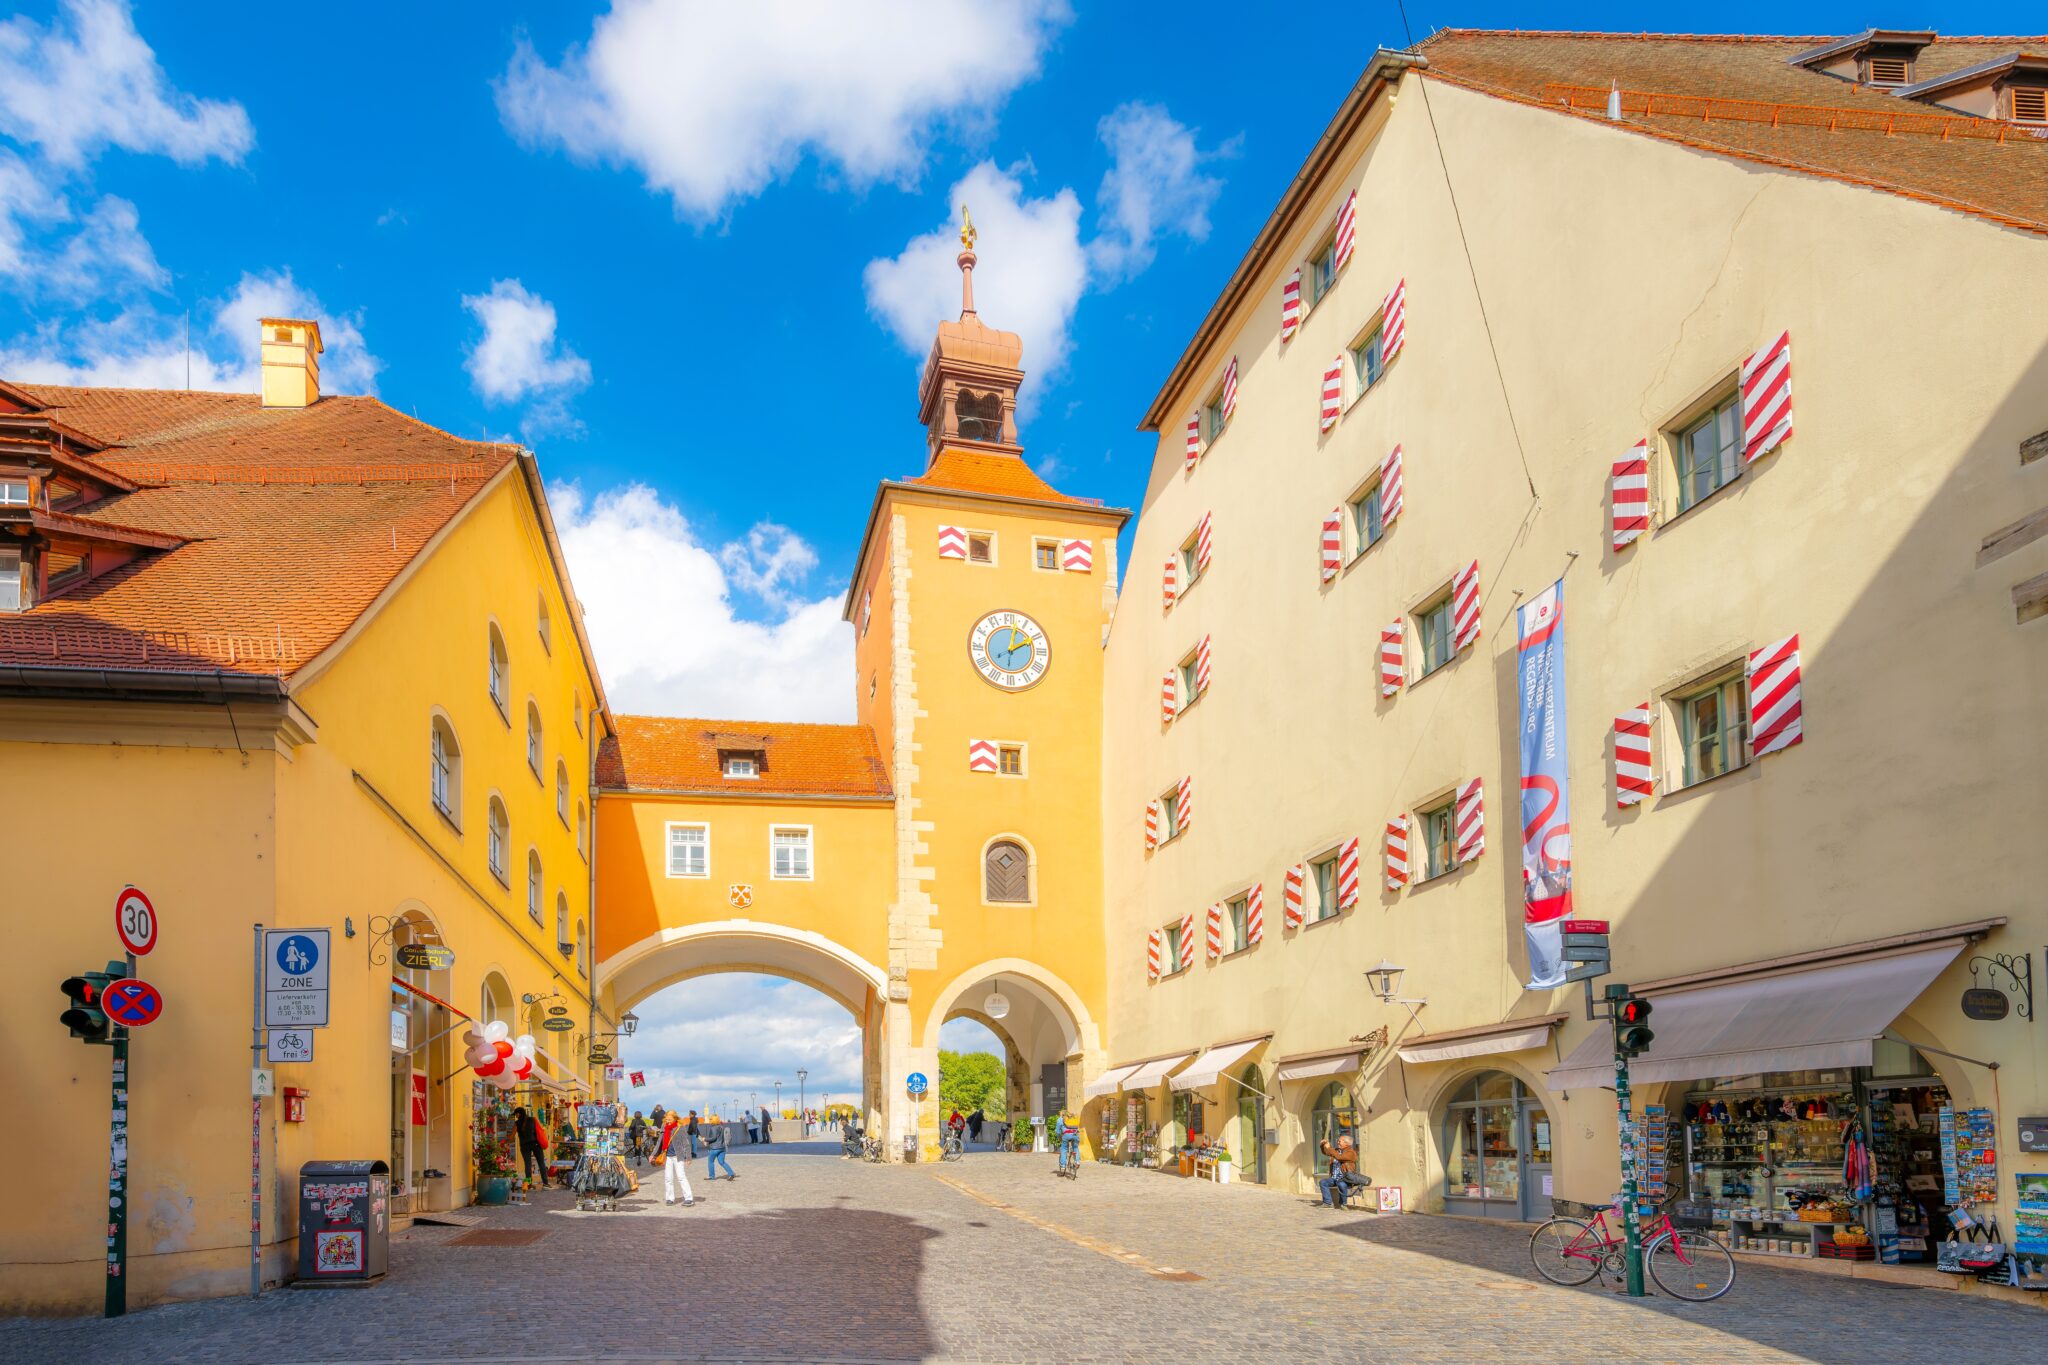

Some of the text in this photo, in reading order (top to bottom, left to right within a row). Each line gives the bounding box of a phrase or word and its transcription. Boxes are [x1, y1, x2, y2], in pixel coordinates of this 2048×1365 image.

[125, 905, 148, 939] 30
[406, 955, 446, 967] ZIERL
[281, 978, 312, 988] ZONE
[283, 1050, 298, 1058] frei
